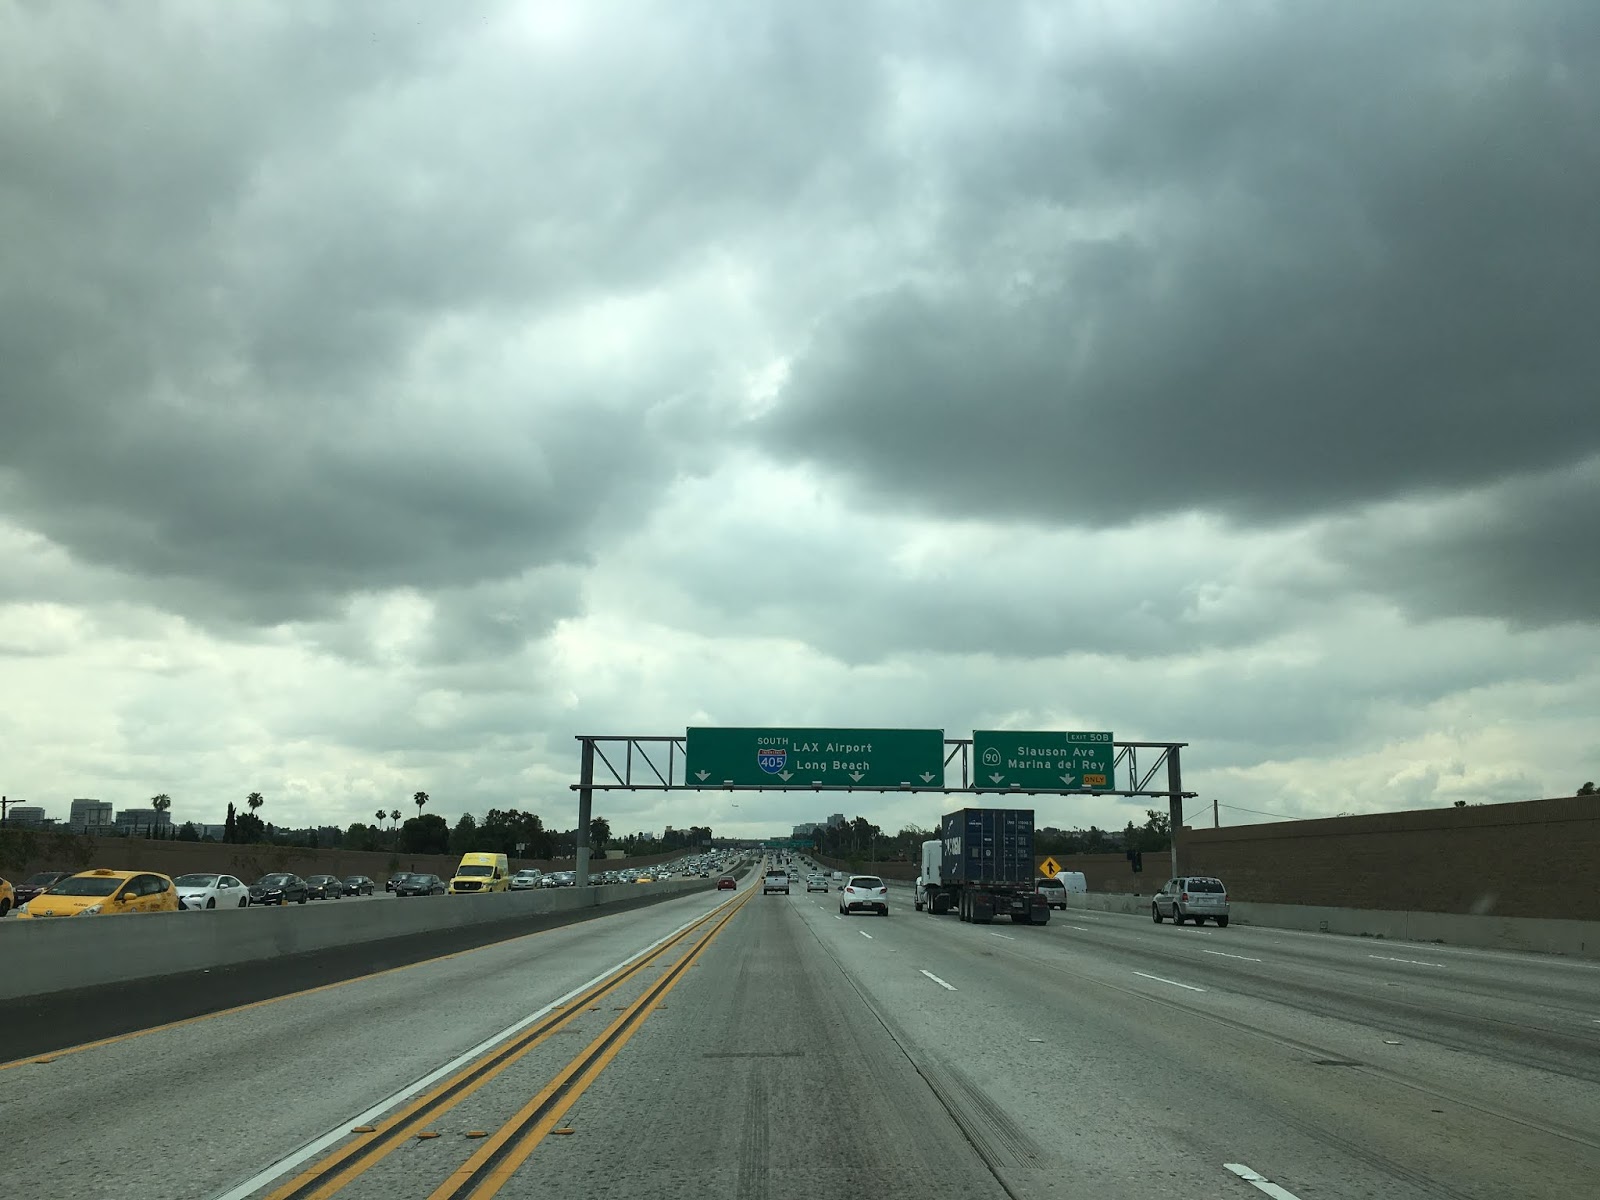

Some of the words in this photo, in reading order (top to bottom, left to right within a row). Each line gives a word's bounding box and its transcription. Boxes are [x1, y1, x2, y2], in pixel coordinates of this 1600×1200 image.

[793, 742, 818, 752] LAX
[826, 742, 872, 754] Airport
[1017, 746, 1067, 756] Slauson
[1073, 747, 1095, 756] Ave
[761, 757, 783, 767] 405
[985, 754, 998, 762] 90
[796, 760, 827, 772] Long
[833, 760, 869, 770] Beach
[1008, 759, 1051, 769] Marina
[1058, 760, 1076, 769] del
[1082, 761, 1105, 771] Rey
